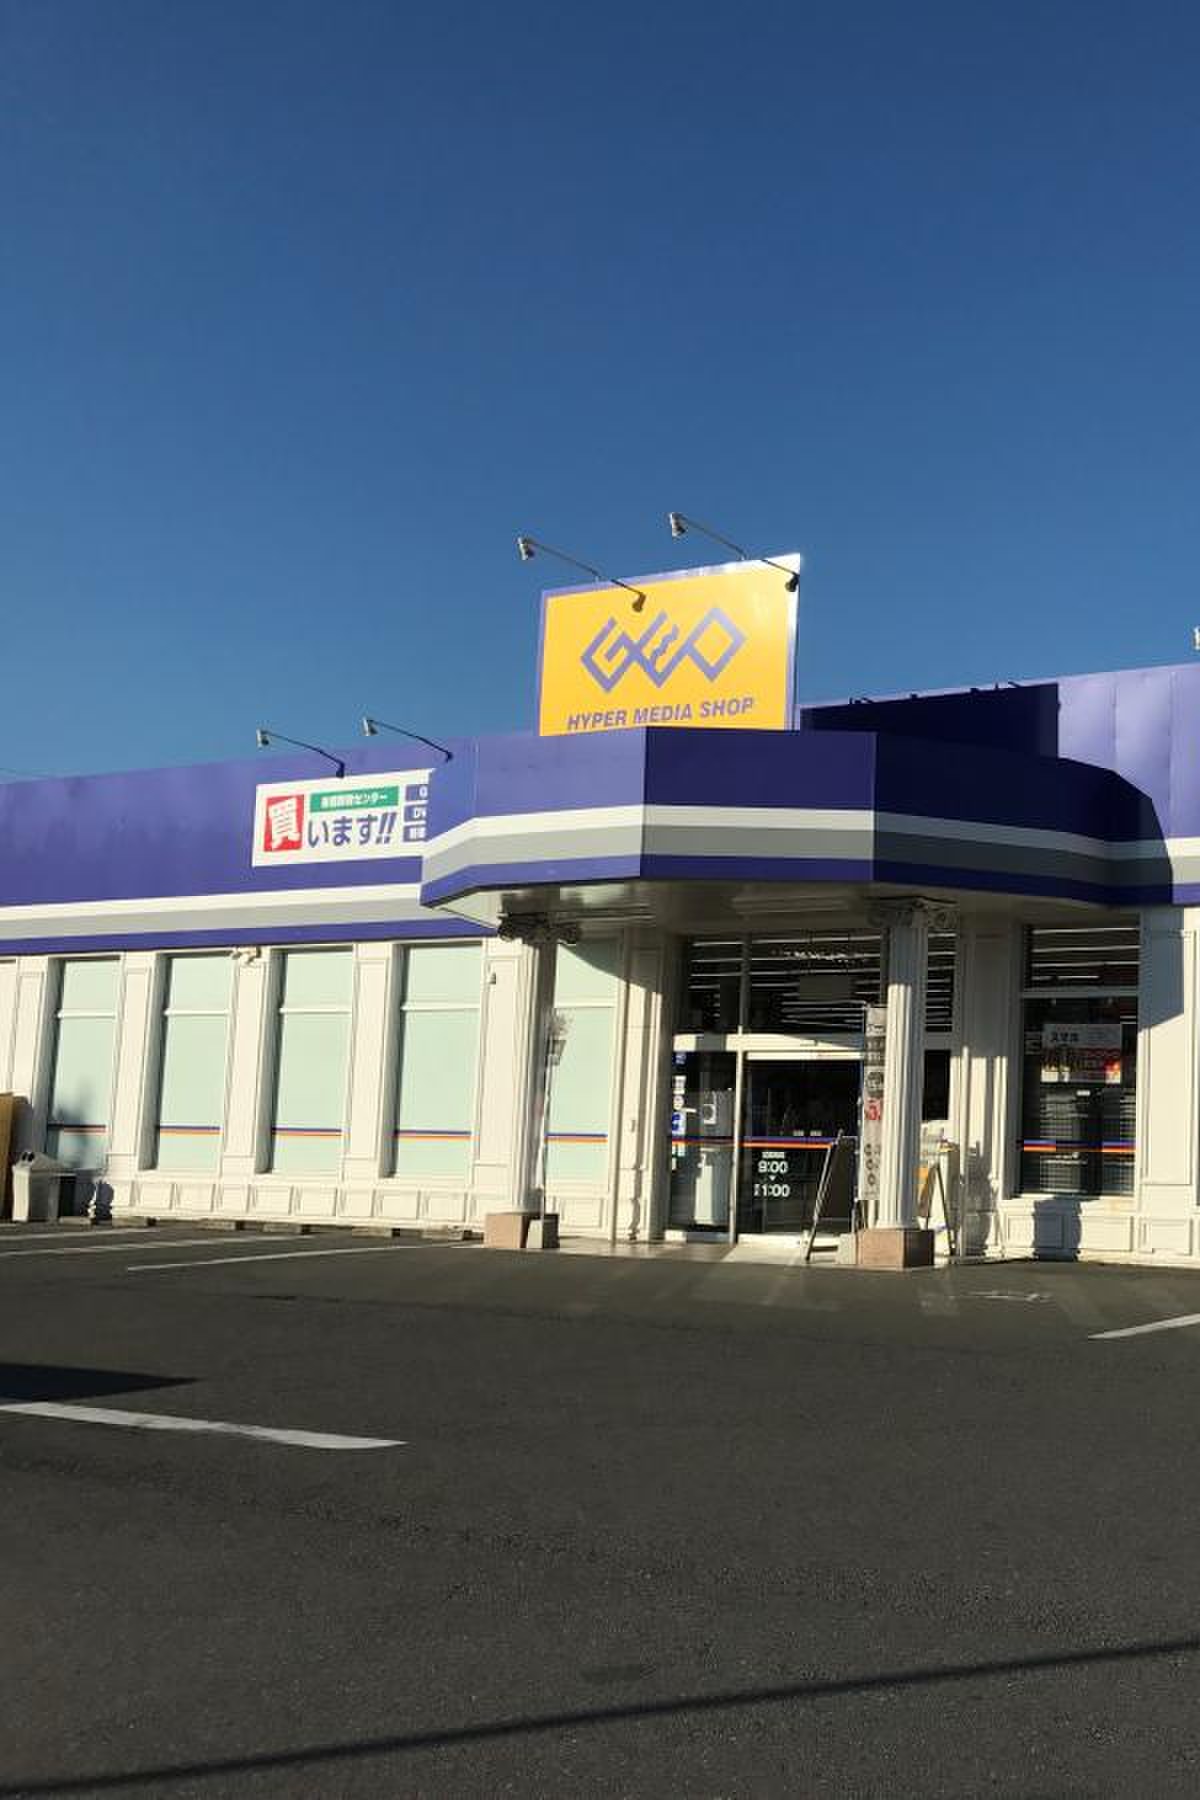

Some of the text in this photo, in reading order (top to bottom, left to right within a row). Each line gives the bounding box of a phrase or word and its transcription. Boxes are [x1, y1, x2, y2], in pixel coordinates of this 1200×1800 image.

[567, 696, 755, 731] HYPER MEDIA SHOP
